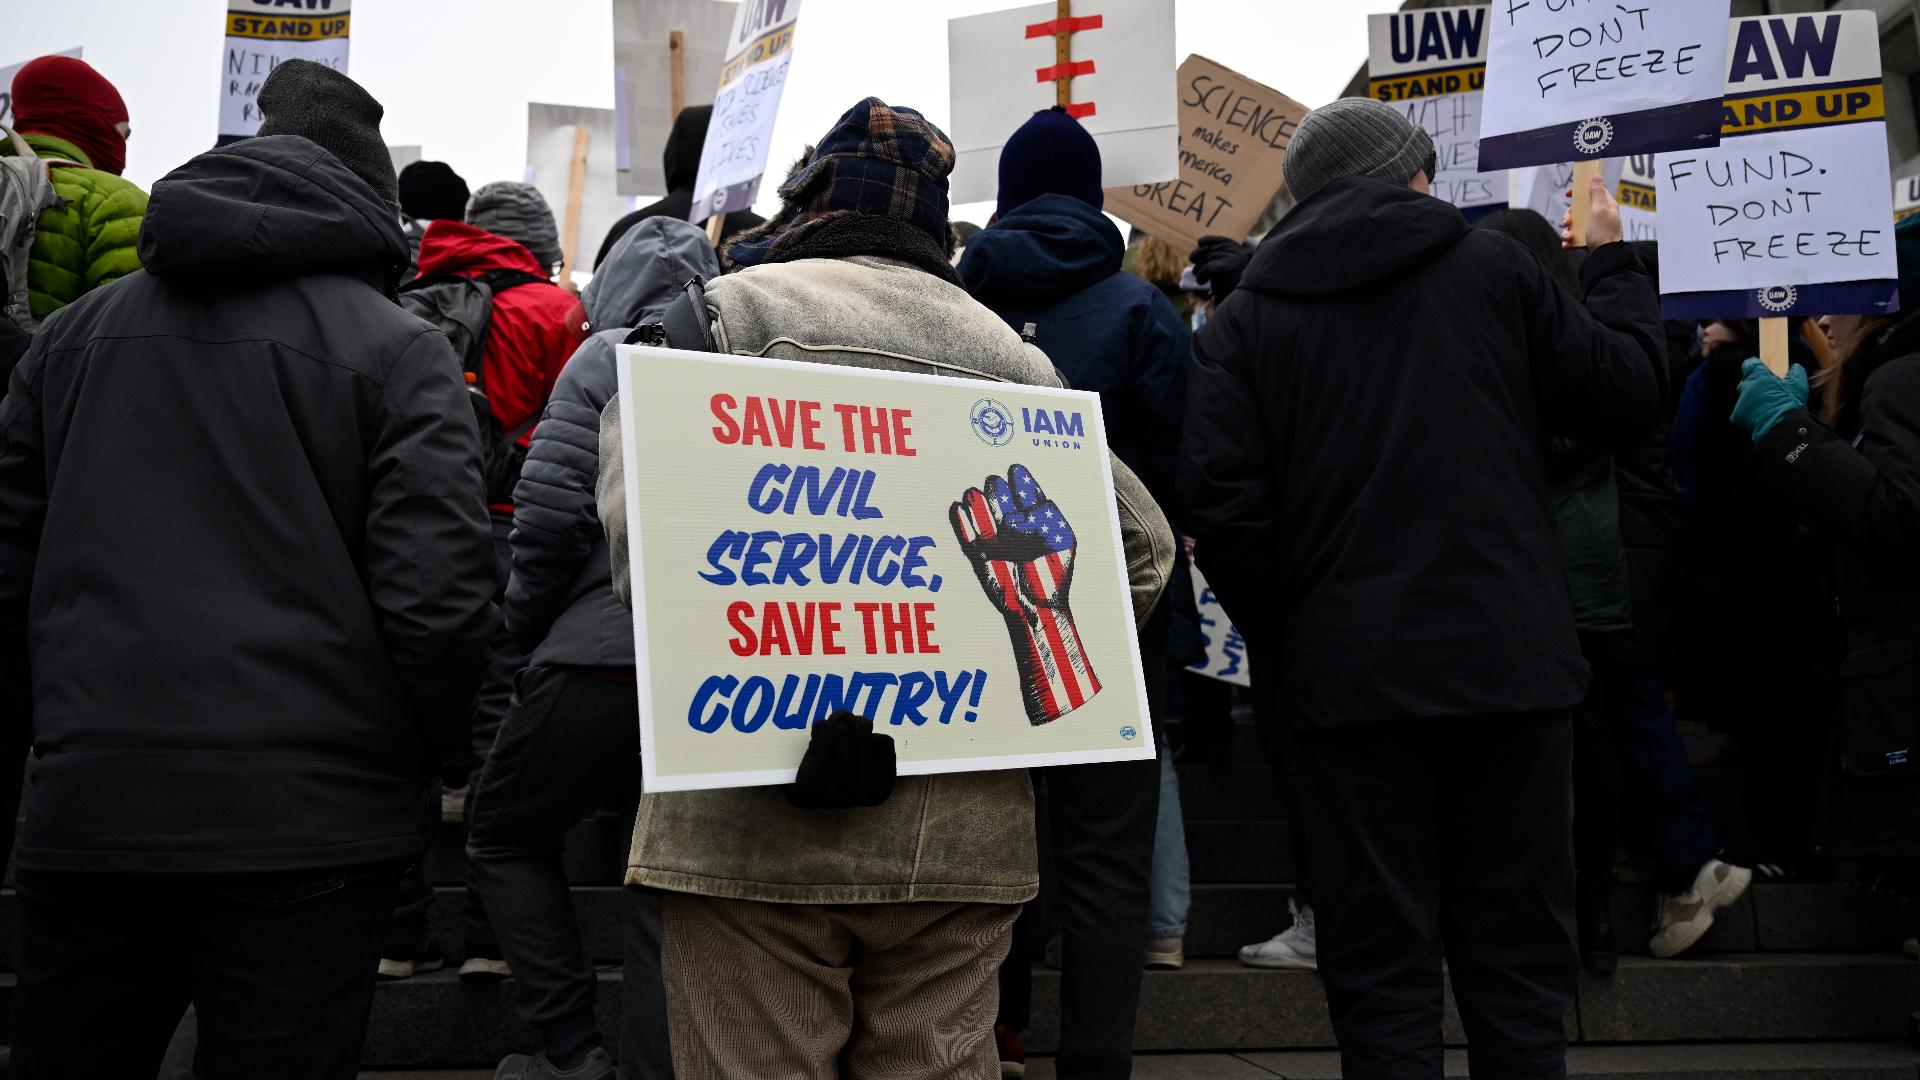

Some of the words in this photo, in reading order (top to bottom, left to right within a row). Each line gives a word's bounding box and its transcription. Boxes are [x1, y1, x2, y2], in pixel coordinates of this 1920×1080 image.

[233, 18, 313, 36] STAND
[320, 20, 347, 36] UP
[1390, 8, 1486, 64] UAW
[1533, 4, 1650, 59] DON'T
[1728, 14, 1842, 83] AW
[1377, 75, 1462, 102] STAND
[1468, 71, 1485, 90] U
[1537, 44, 1702, 99] FREEZE
[1182, 75, 1299, 151] SCIENCE
[1721, 97, 1802, 127] AND
[1816, 92, 1871, 117] UP
[1192, 126, 1240, 155] makes
[1584, 130, 1602, 140] UAW
[1178, 136, 1233, 187] merica
[1431, 177, 1493, 204] IVES
[1706, 187, 1822, 226] DON'T
[1713, 229, 1882, 264] FREEZE
[1769, 291, 1786, 299] UAW
[709, 393, 824, 451] SAVE
[834, 403, 917, 457] THE
[1021, 407, 1084, 438] IAM
[1033, 438, 1081, 450] UNION
[747, 463, 883, 520] CIVIL
[698, 529, 943, 593] SERVICE,
[726, 600, 846, 657] SAVE
[854, 601, 941, 655] THE
[687, 668, 988, 734] COUNTRY!
